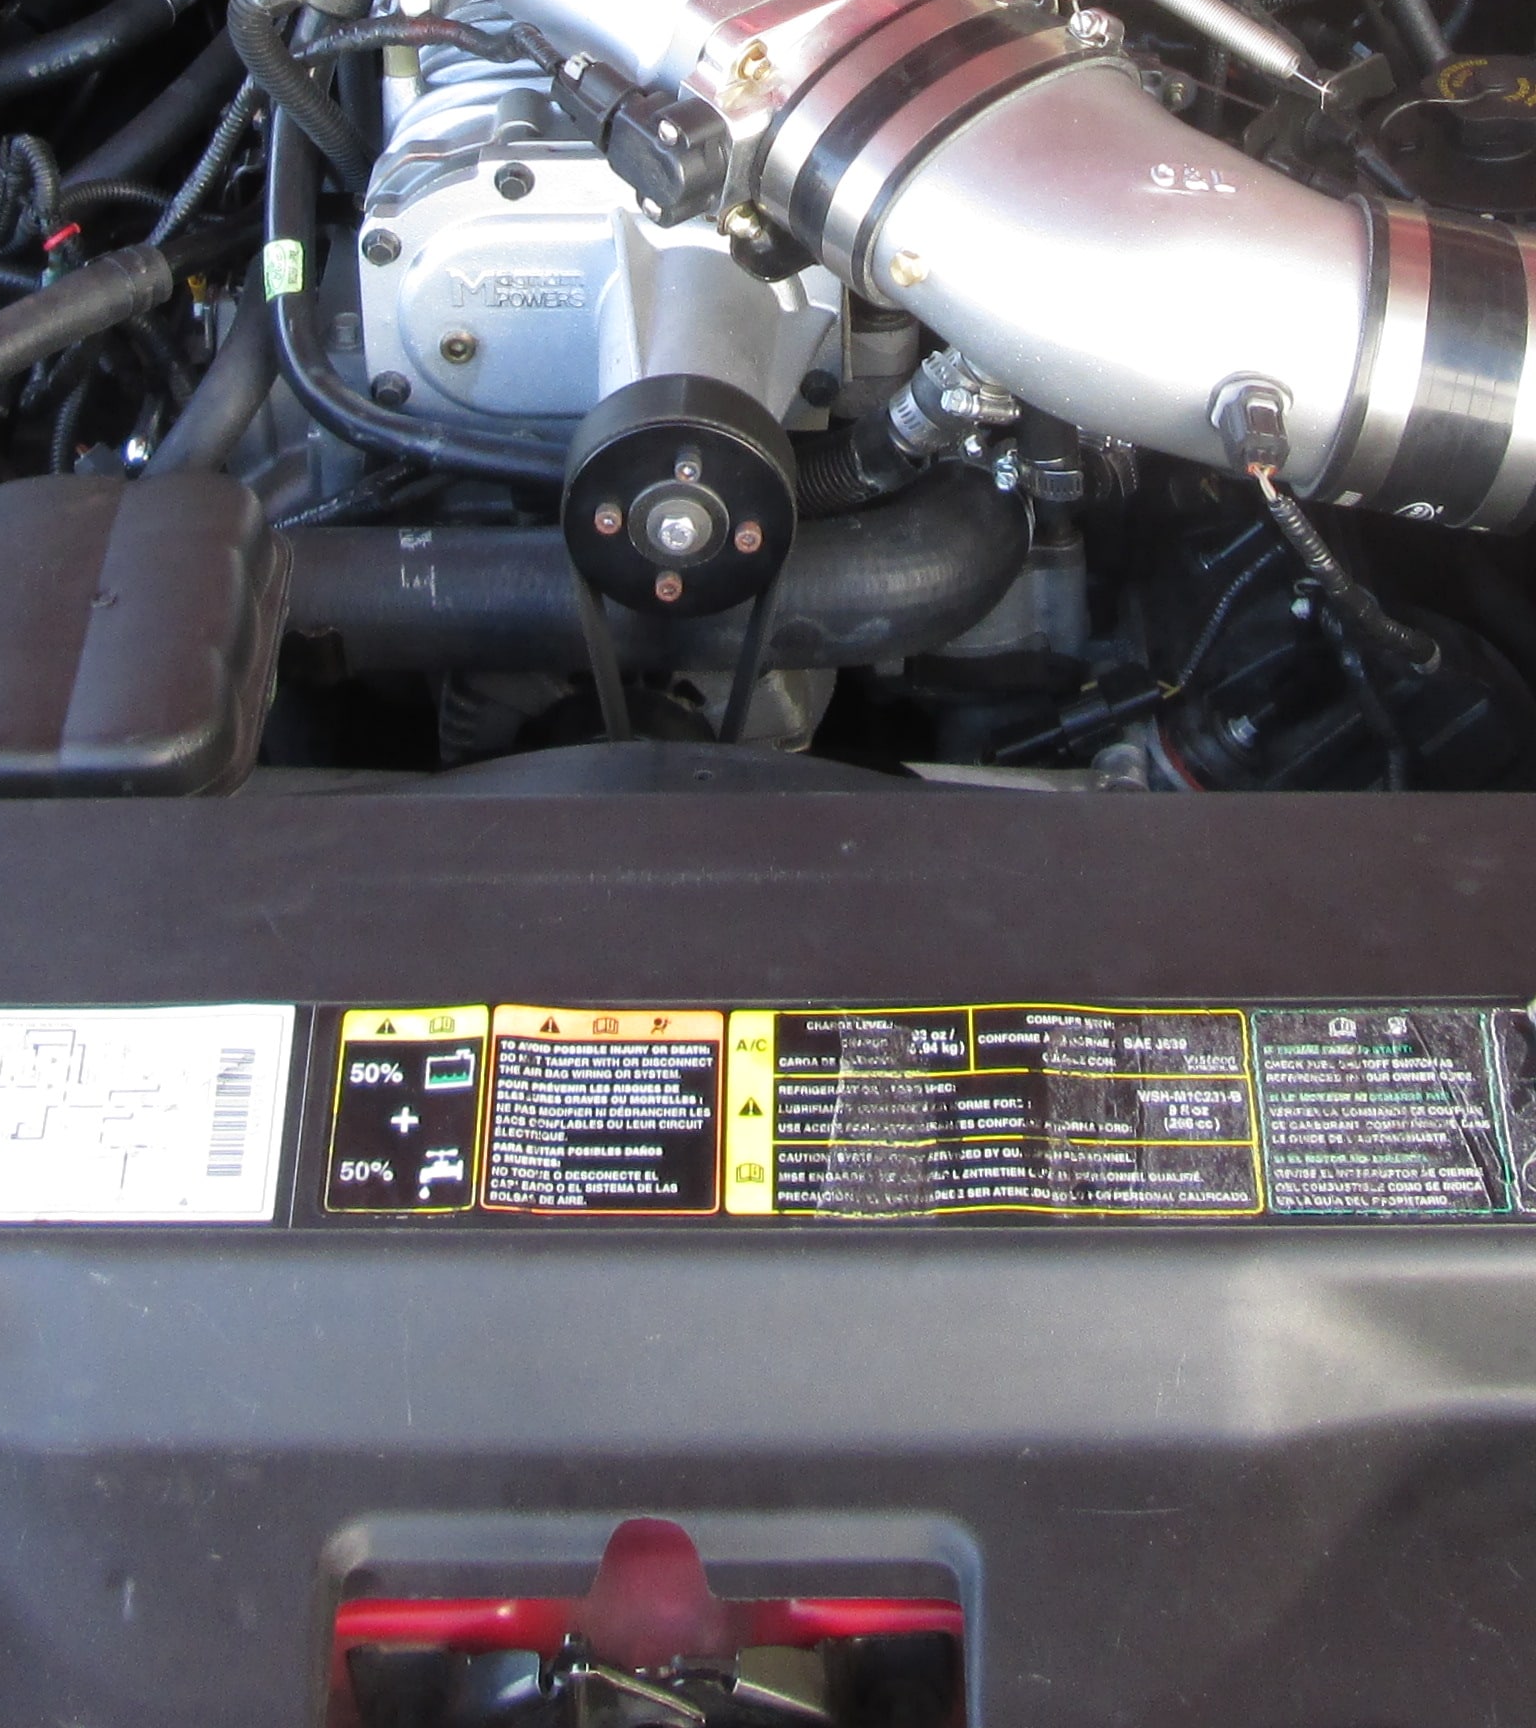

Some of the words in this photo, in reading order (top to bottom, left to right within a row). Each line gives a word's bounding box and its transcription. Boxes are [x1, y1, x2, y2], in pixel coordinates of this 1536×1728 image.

[930, 1030, 948, 1041] oz
[977, 1032, 1041, 1045] CONFORME
[500, 1040, 516, 1051] TO
[518, 1041, 552, 1054] AVOID
[553, 1044, 608, 1055] POSSIBLE
[610, 1044, 650, 1055] INJURY
[651, 1044, 668, 1055] OR
[735, 1037, 768, 1053] A/C
[1123, 1037, 1153, 1050] SAE
[1154, 1037, 1188, 1050] J639
[499, 1052, 516, 1063] DO
[519, 1053, 542, 1065] NT
[544, 1056, 590, 1068] TAMPER
[591, 1056, 620, 1068] WITH
[622, 1056, 640, 1068] OR
[641, 1056, 713, 1068] DISCONNECT
[820, 1056, 836, 1067] DE
[349, 1061, 404, 1084] 50%
[498, 1064, 520, 1076] THE
[522, 1065, 544, 1078] AIR
[544, 1067, 570, 1080] BAG
[571, 1068, 613, 1080] WIRING
[614, 1068, 632, 1080] OR
[633, 1068, 682, 1080] SYSTEM.
[1392, 1071, 1436, 1083] OWNER
[497, 1078, 529, 1091] POUR
[589, 1082, 612, 1094] LES
[613, 1082, 662, 1094] RISQUES
[663, 1082, 681, 1094] DE
[565, 1093, 608, 1105] GRAVES
[610, 1093, 628, 1105] OU
[629, 1093, 697, 1105] MORTELLES
[495, 1102, 512, 1114] NE
[513, 1103, 537, 1116] PAS
[538, 1105, 593, 1118] MODIFIER
[594, 1107, 607, 1117] NI
[688, 1106, 712, 1118] LES
[495, 1115, 526, 1127] SACS
[606, 1118, 623, 1130] OU
[625, 1119, 656, 1130] LEUR
[658, 1119, 705, 1130] CIRCUIT
[777, 1122, 801, 1134] USE
[492, 1142, 524, 1155] PARA
[525, 1144, 566, 1157] EVITAR
[566, 1146, 623, 1158] POSIBLES
[624, 1144, 664, 1158] DAÑOS
[983, 1148, 1000, 1159] BY
[491, 1153, 502, 1164] O
[339, 1159, 394, 1182] 50%
[490, 1166, 510, 1177] NO
[553, 1170, 563, 1181] O
[564, 1169, 642, 1182] DESCONECTE
[643, 1170, 660, 1182] EL
[555, 1182, 566, 1194] O
[567, 1182, 583, 1194] EL
[584, 1182, 635, 1194] SISTEMA
[636, 1182, 653, 1194] DE
[654, 1182, 679, 1194] LAS
[966, 1186, 991, 1198] SER
[538, 1194, 555, 1205] DE
